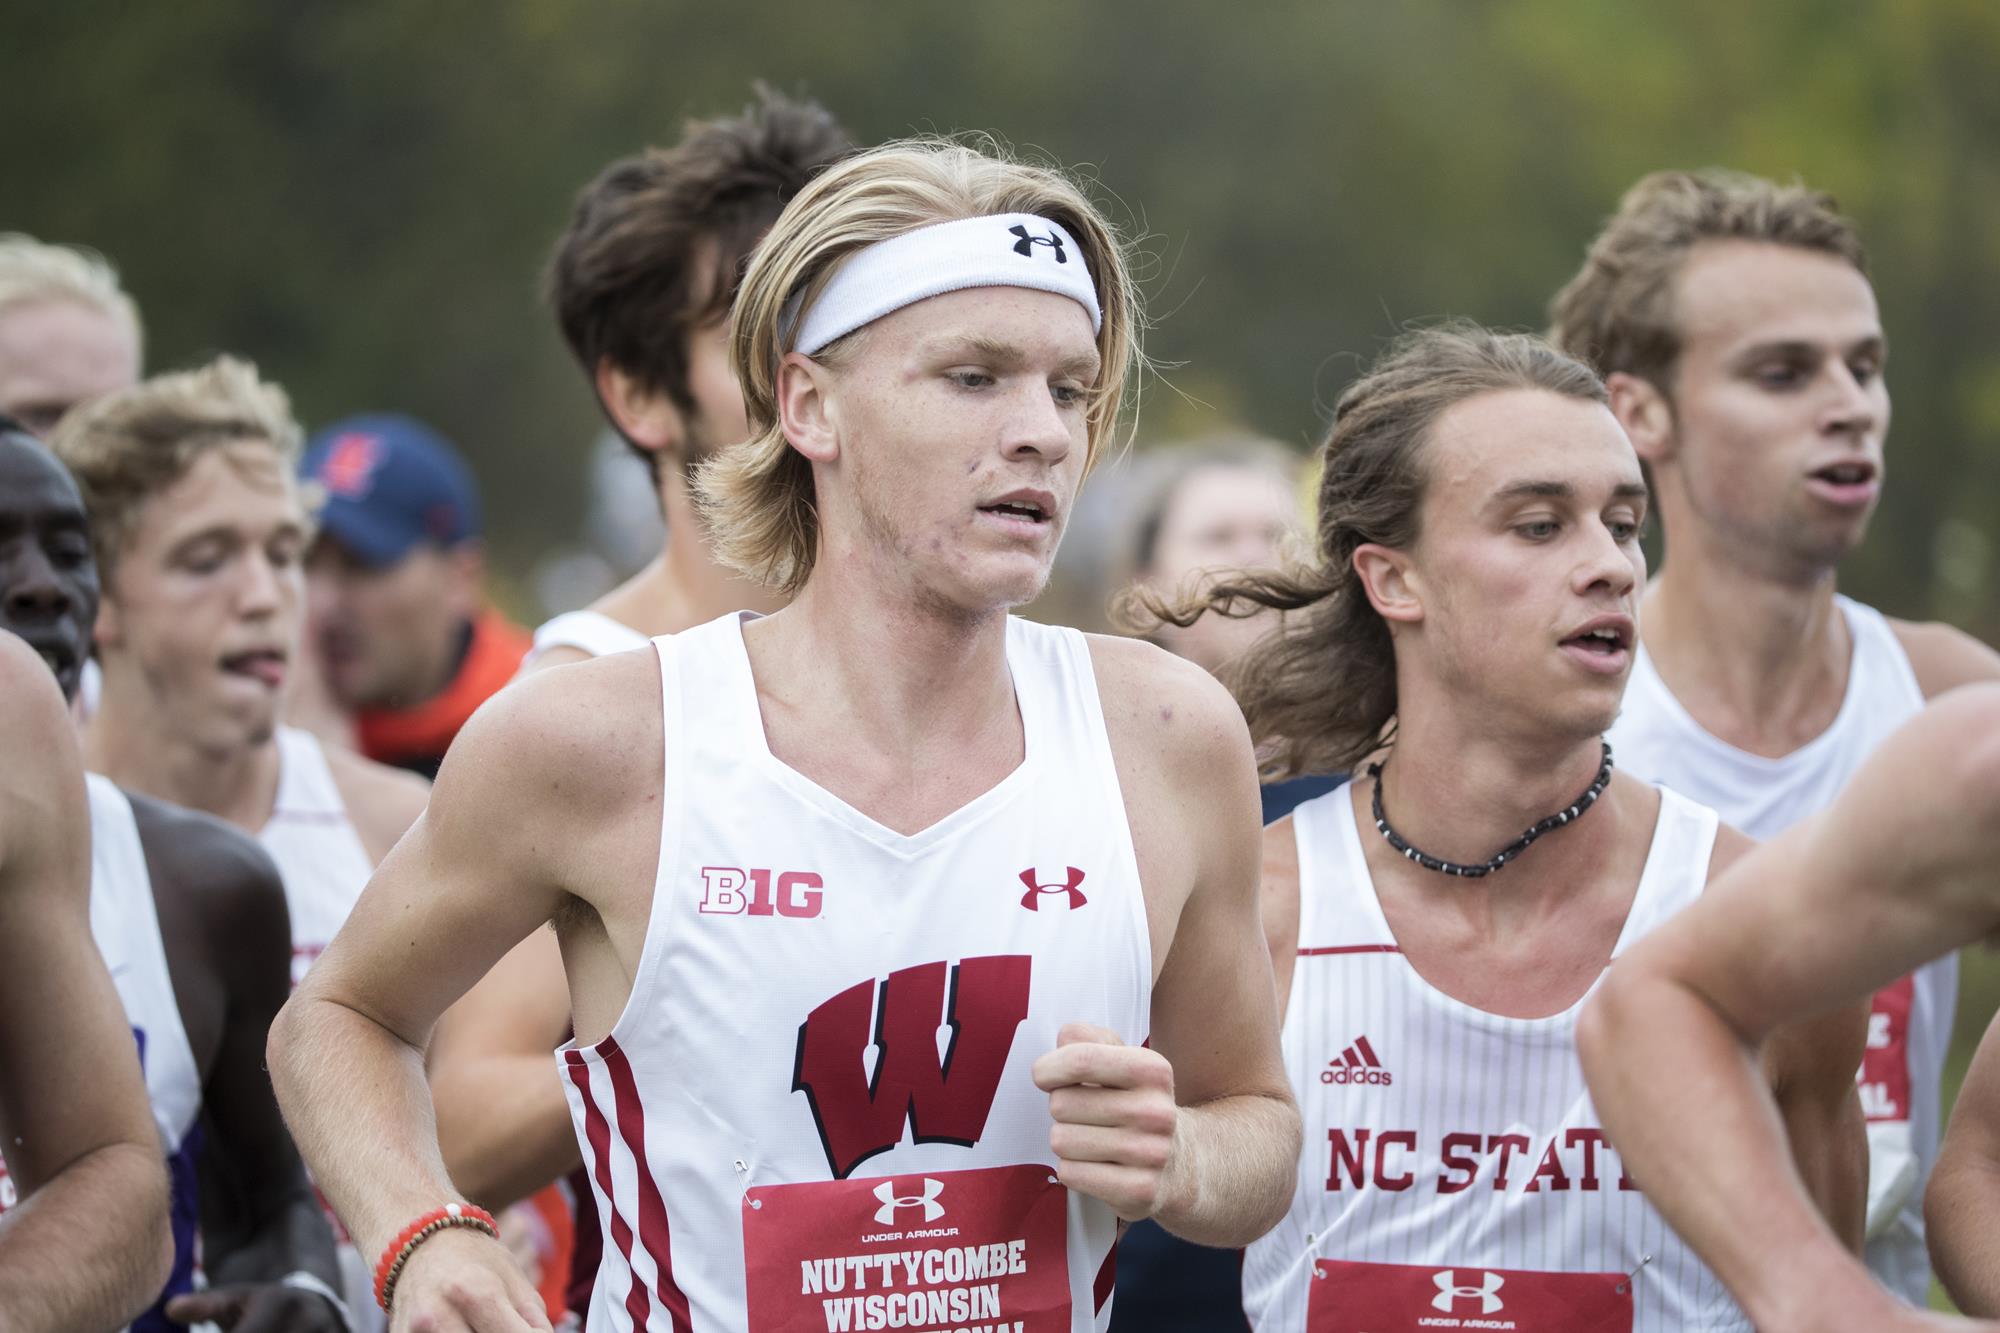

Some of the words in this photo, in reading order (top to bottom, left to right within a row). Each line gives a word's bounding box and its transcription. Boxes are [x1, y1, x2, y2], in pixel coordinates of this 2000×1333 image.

[791, 954, 1032, 1180] W
[1320, 1066, 1392, 1086] adidas
[1326, 1128, 1417, 1192] NC
[861, 1232, 903, 1243] UNDER
[906, 1227, 960, 1240] ARMOUR
[801, 1239, 1027, 1295] NUTTYCOMBE
[822, 1283, 1001, 1333] WISCONSIN
[1418, 1317, 1460, 1327] UNDER
[1462, 1319, 1516, 1330] ARMOUR
